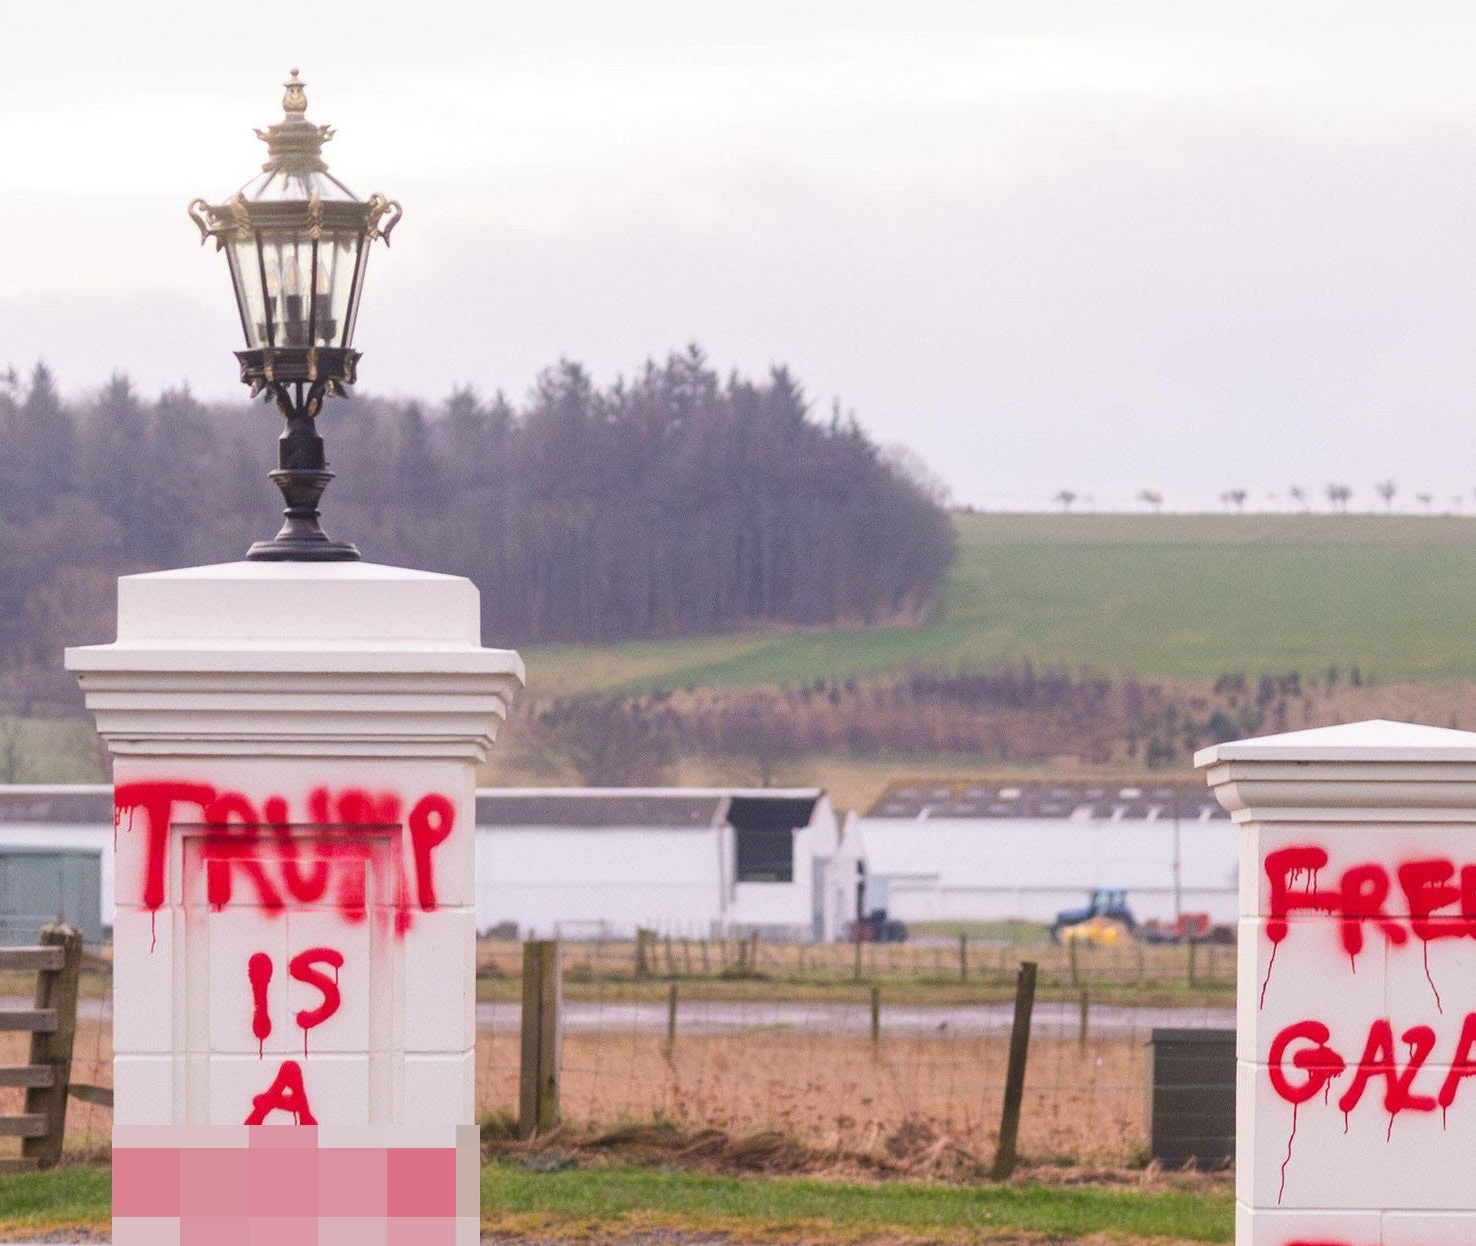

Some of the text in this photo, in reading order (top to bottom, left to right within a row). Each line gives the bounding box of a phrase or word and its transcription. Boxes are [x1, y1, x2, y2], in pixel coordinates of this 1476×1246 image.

[112, 781, 456, 930] TRUMP
[248, 948, 344, 1040] IS
[243, 1060, 319, 1126] A
